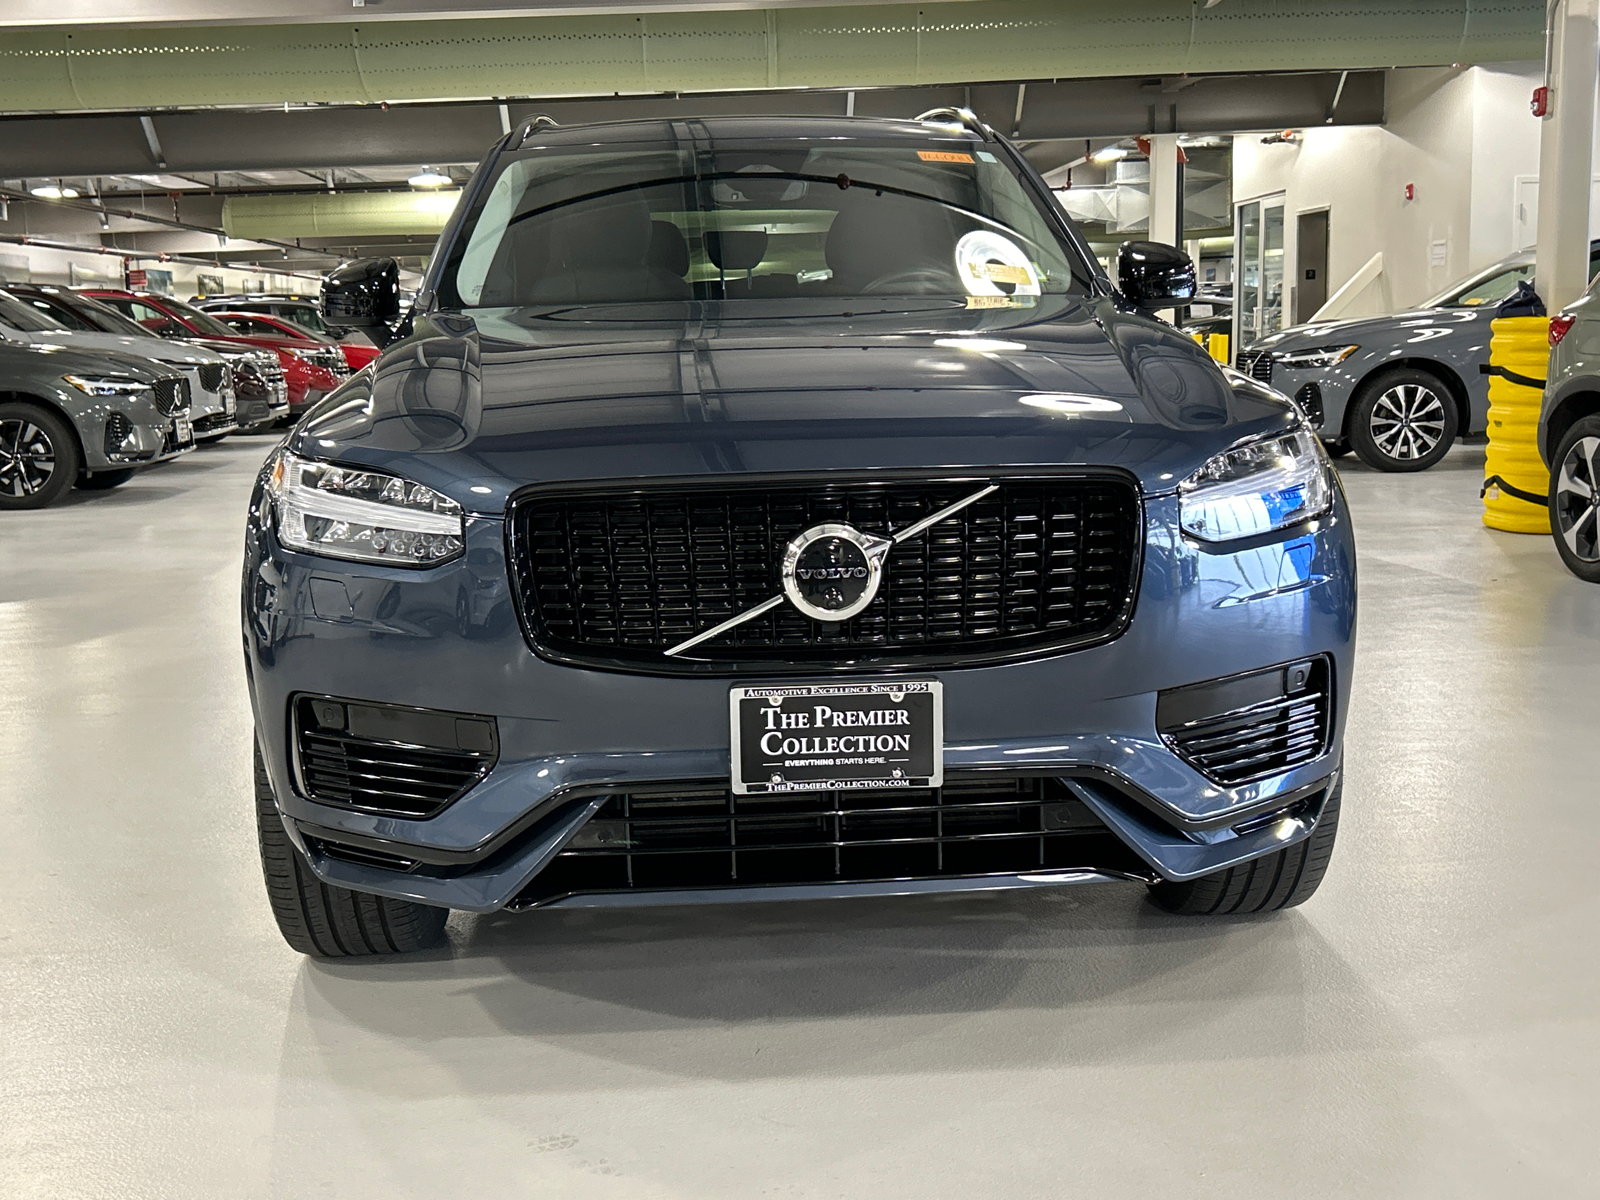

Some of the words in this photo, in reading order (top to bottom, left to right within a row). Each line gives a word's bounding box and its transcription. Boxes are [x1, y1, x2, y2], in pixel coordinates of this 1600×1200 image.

[797, 567, 867, 579] VOLVO
[746, 688, 808, 697] AUTOMOTIVE
[810, 686, 868, 695] EXCELLENCE
[870, 684, 899, 693] SINCE
[902, 683, 928, 692] 1995
[760, 707, 810, 729] THE
[813, 705, 911, 728] PREMIER
[760, 731, 911, 756] COLLECTION
[785, 759, 834, 767] EVERYTHING
[835, 757, 863, 765] STARTS
[766, 779, 910, 792] THEPREMIERCOLLECTION.COM
